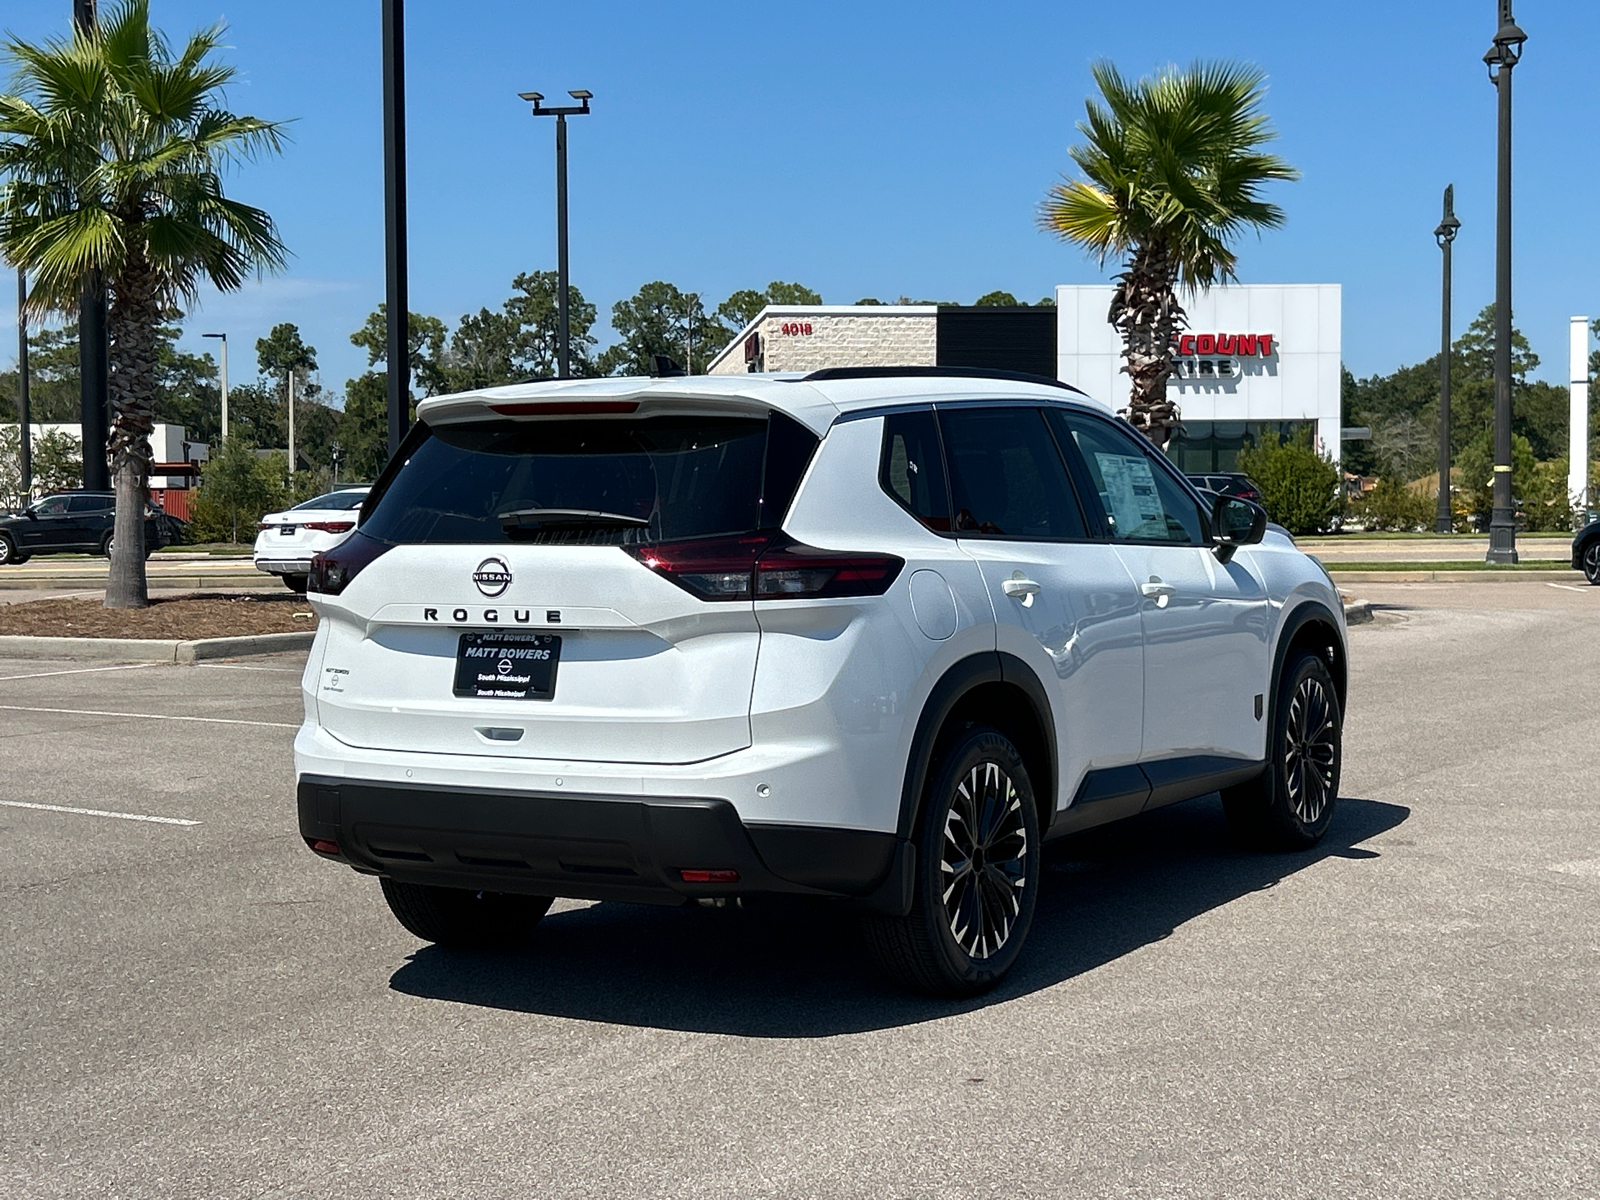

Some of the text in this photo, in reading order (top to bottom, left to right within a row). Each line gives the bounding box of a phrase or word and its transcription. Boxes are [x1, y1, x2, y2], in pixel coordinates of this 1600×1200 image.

[781, 322, 813, 337] 4018
[1173, 333, 1273, 356] COUNT
[473, 573, 511, 582] NISSAN
[424, 608, 562, 623] ROGUE
[503, 634, 536, 642] BOWERS
[465, 647, 551, 660] MATT BOWERS
[477, 673, 496, 682] South
